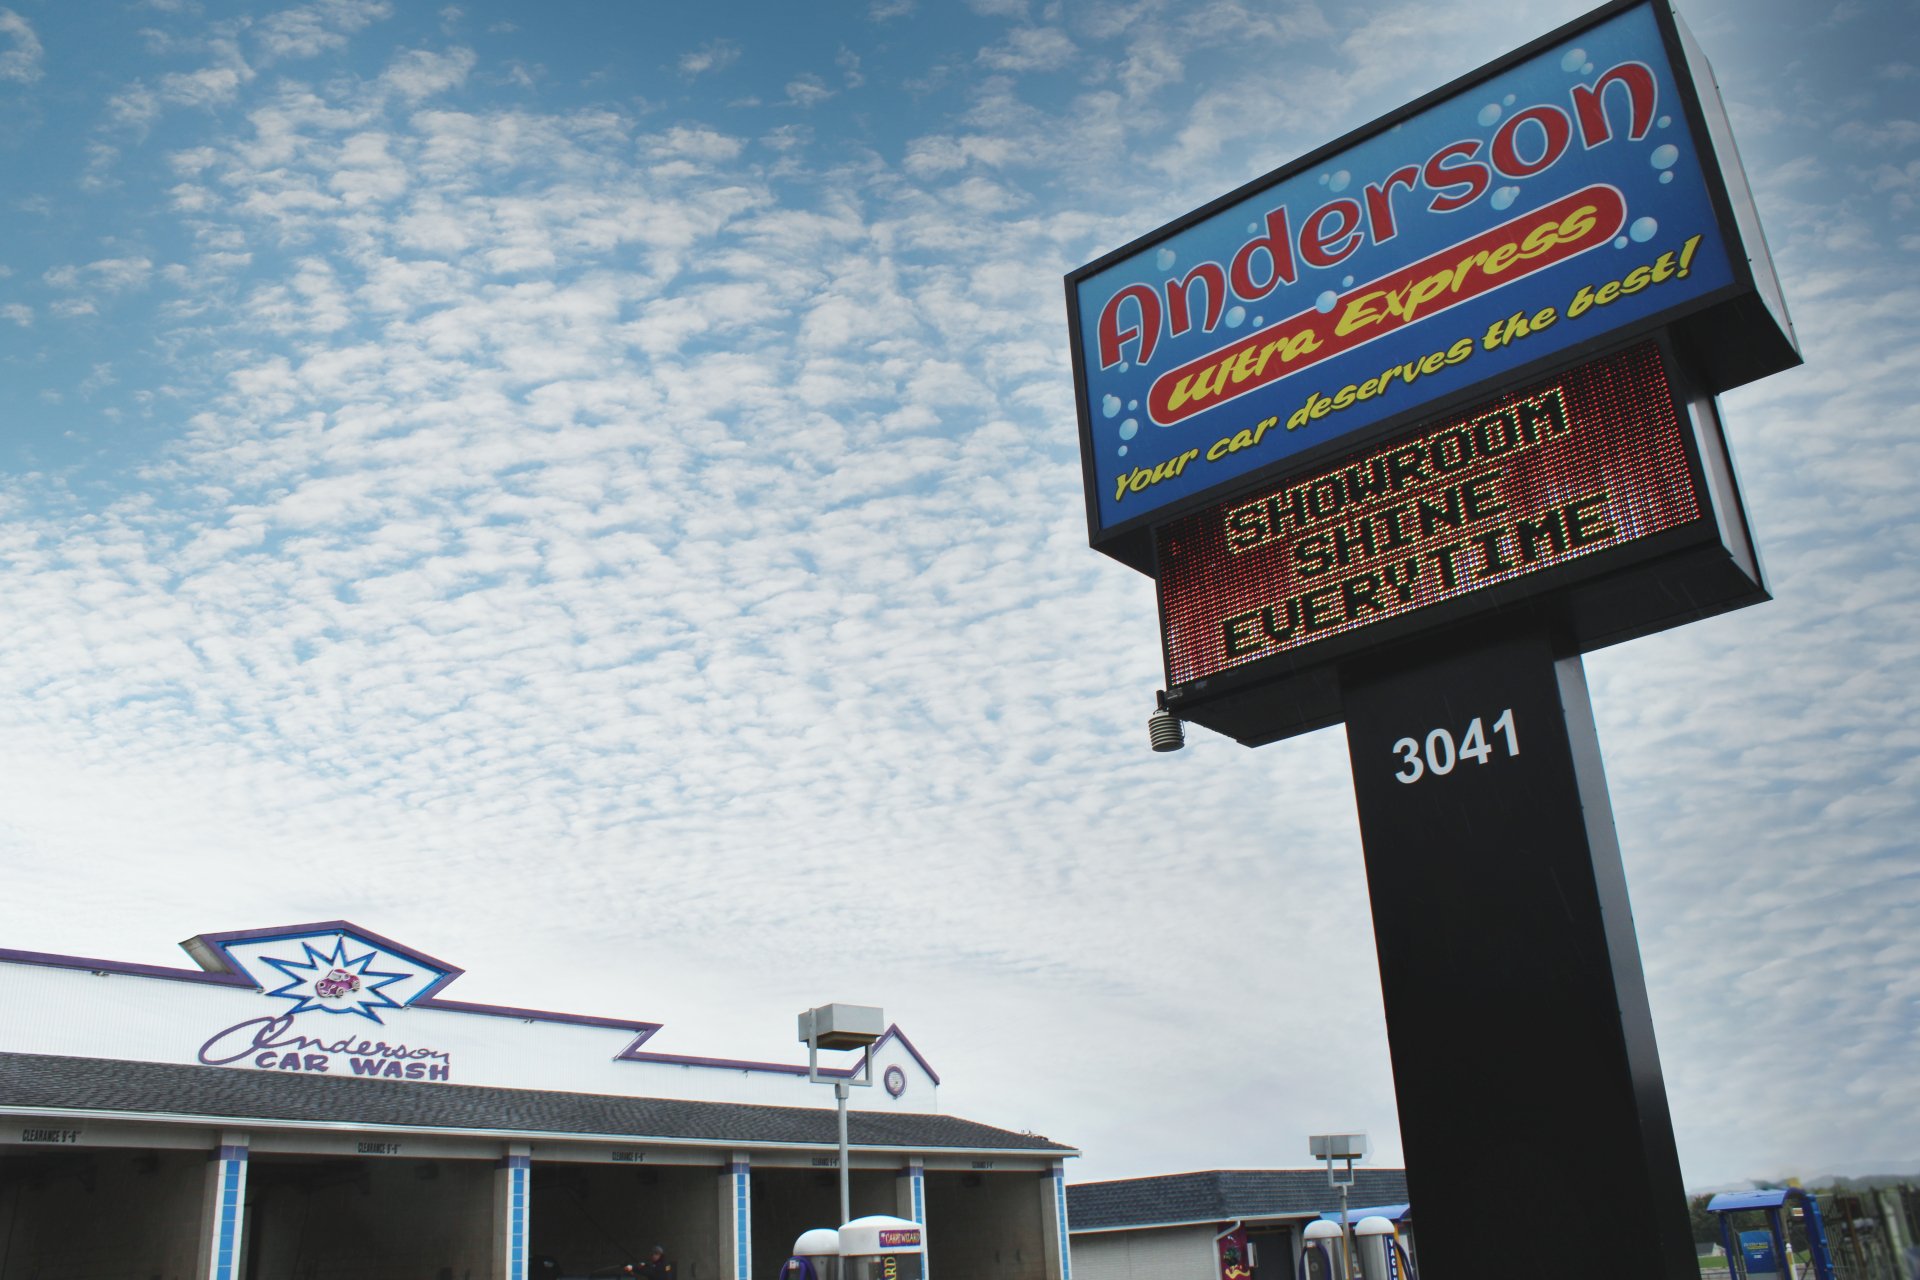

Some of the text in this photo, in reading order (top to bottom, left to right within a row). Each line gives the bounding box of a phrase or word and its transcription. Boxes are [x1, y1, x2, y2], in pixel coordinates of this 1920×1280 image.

[1097, 59, 1658, 371] Anderson
[1114, 234, 1702, 501] Your car deserves the best!
[1167, 205, 1598, 411] Ultra Express
[1227, 388, 1569, 553] SHOWROOM
[1294, 476, 1506, 579] SHINE
[1223, 492, 1617, 658] EVERYTIME
[1392, 708, 1520, 784] 3041
[198, 1013, 450, 1065] Anderson
[255, 1051, 449, 1081] CAR WASH
[22, 1129, 60, 1143] CLEARANCE
